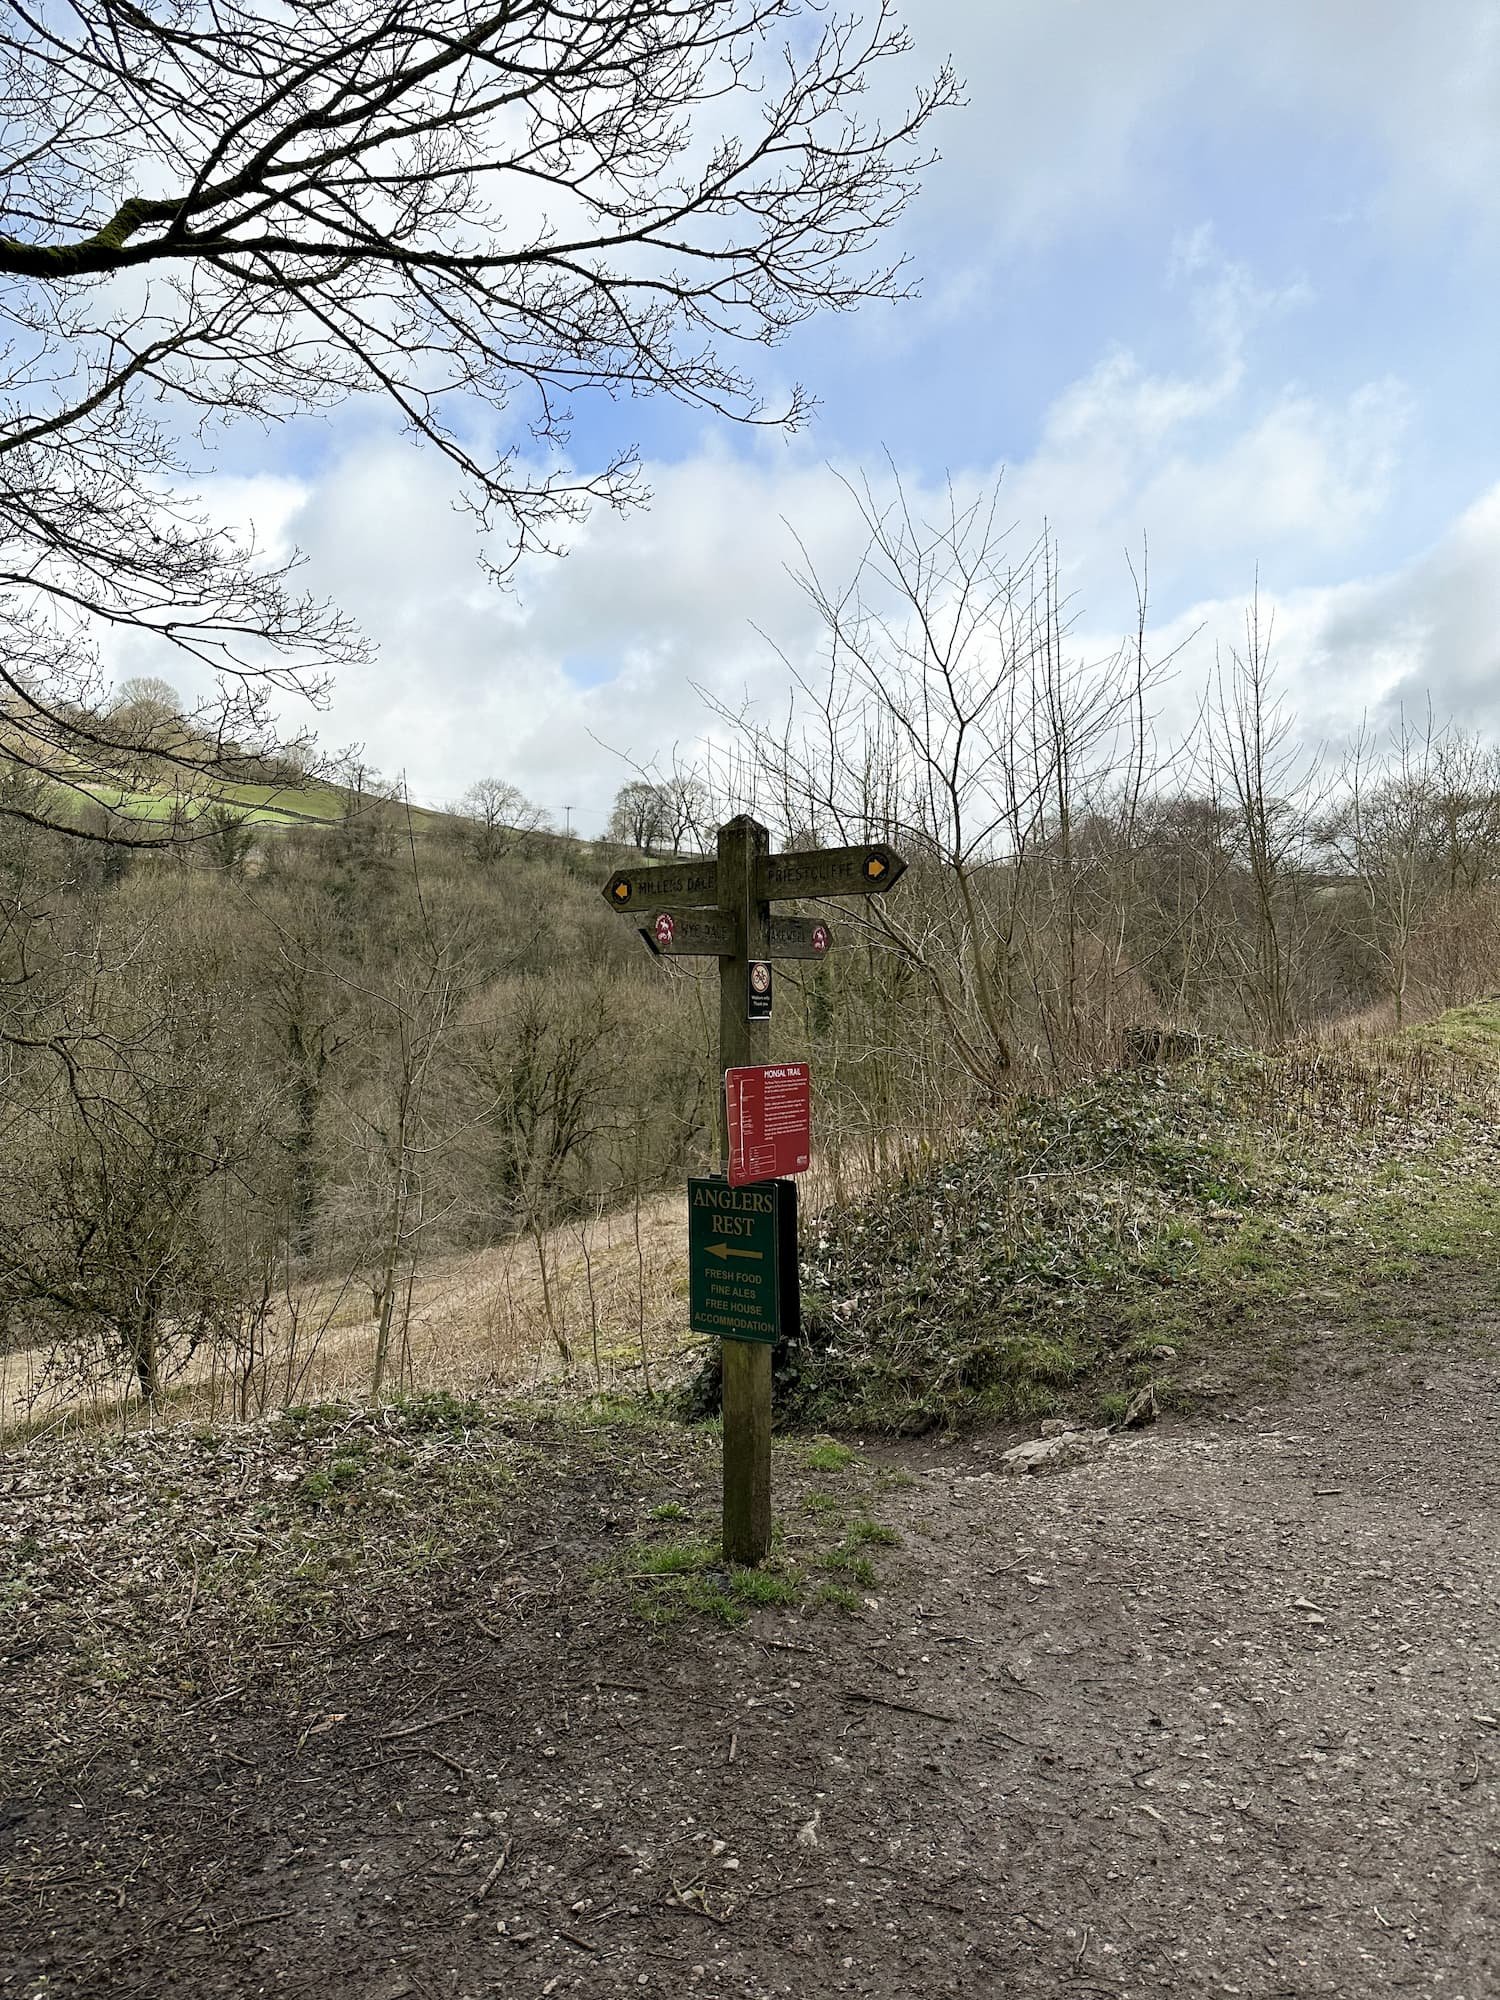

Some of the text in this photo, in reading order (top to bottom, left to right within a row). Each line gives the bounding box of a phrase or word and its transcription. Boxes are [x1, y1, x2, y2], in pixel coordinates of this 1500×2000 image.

[768, 862, 854, 883] PRIESTCLIFFE
[687, 873, 714, 890] DALE
[764, 1068, 801, 1078] MONSAL TRAIL
[693, 1187, 773, 1213] ANGLERS
[712, 1214, 755, 1236] REST
[704, 1268, 762, 1284] FRESH FOOD
[711, 1284, 756, 1299] FINE ALES
[705, 1298, 763, 1315] FREE HOUSE
[695, 1312, 775, 1333] ACCOMMODATION
